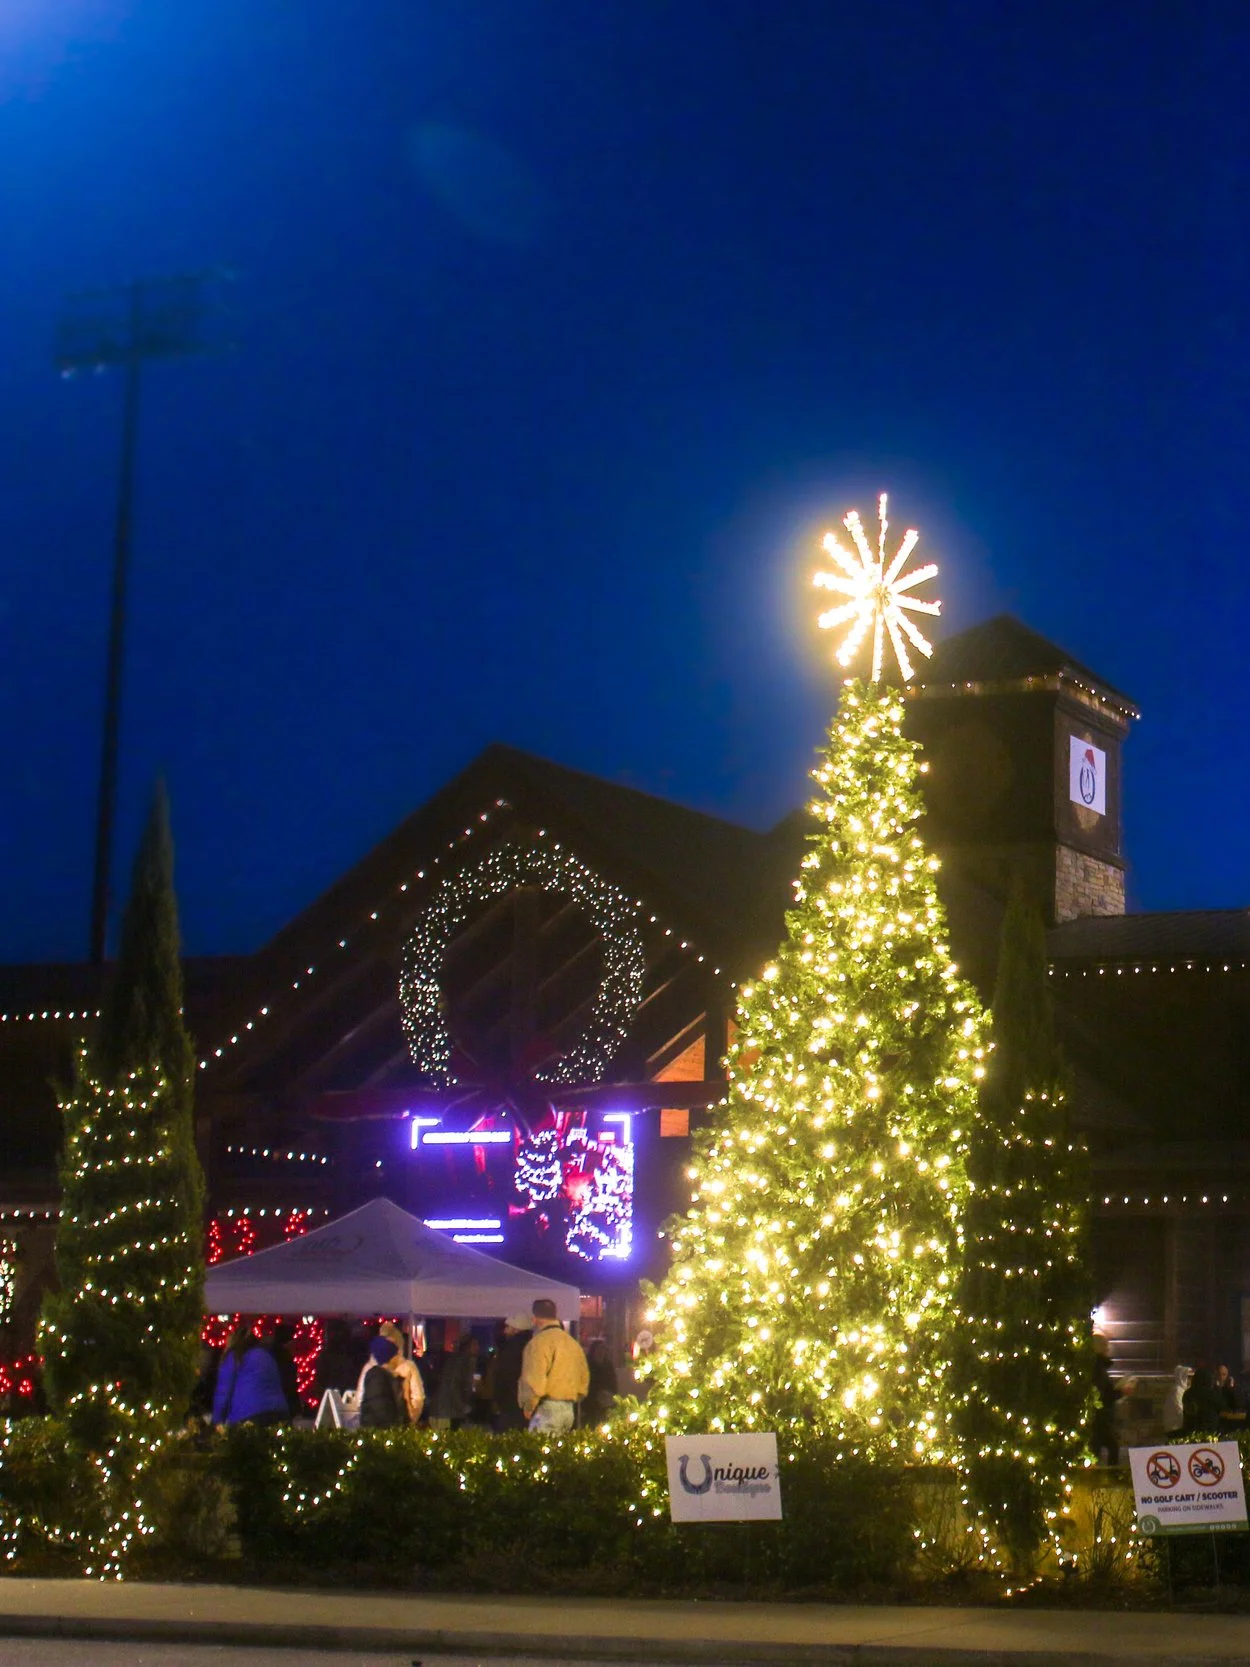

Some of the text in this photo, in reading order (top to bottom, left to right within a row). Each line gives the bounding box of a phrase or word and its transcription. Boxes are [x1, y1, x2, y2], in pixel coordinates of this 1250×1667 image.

[1141, 1496, 1153, 1505] NO
[1154, 1495, 1174, 1504] GOLF
[1175, 1494, 1196, 1503] CART
[1202, 1491, 1238, 1501] SCOOTER
[1158, 1503, 1224, 1513] PARKING ON SIDEWALKS
